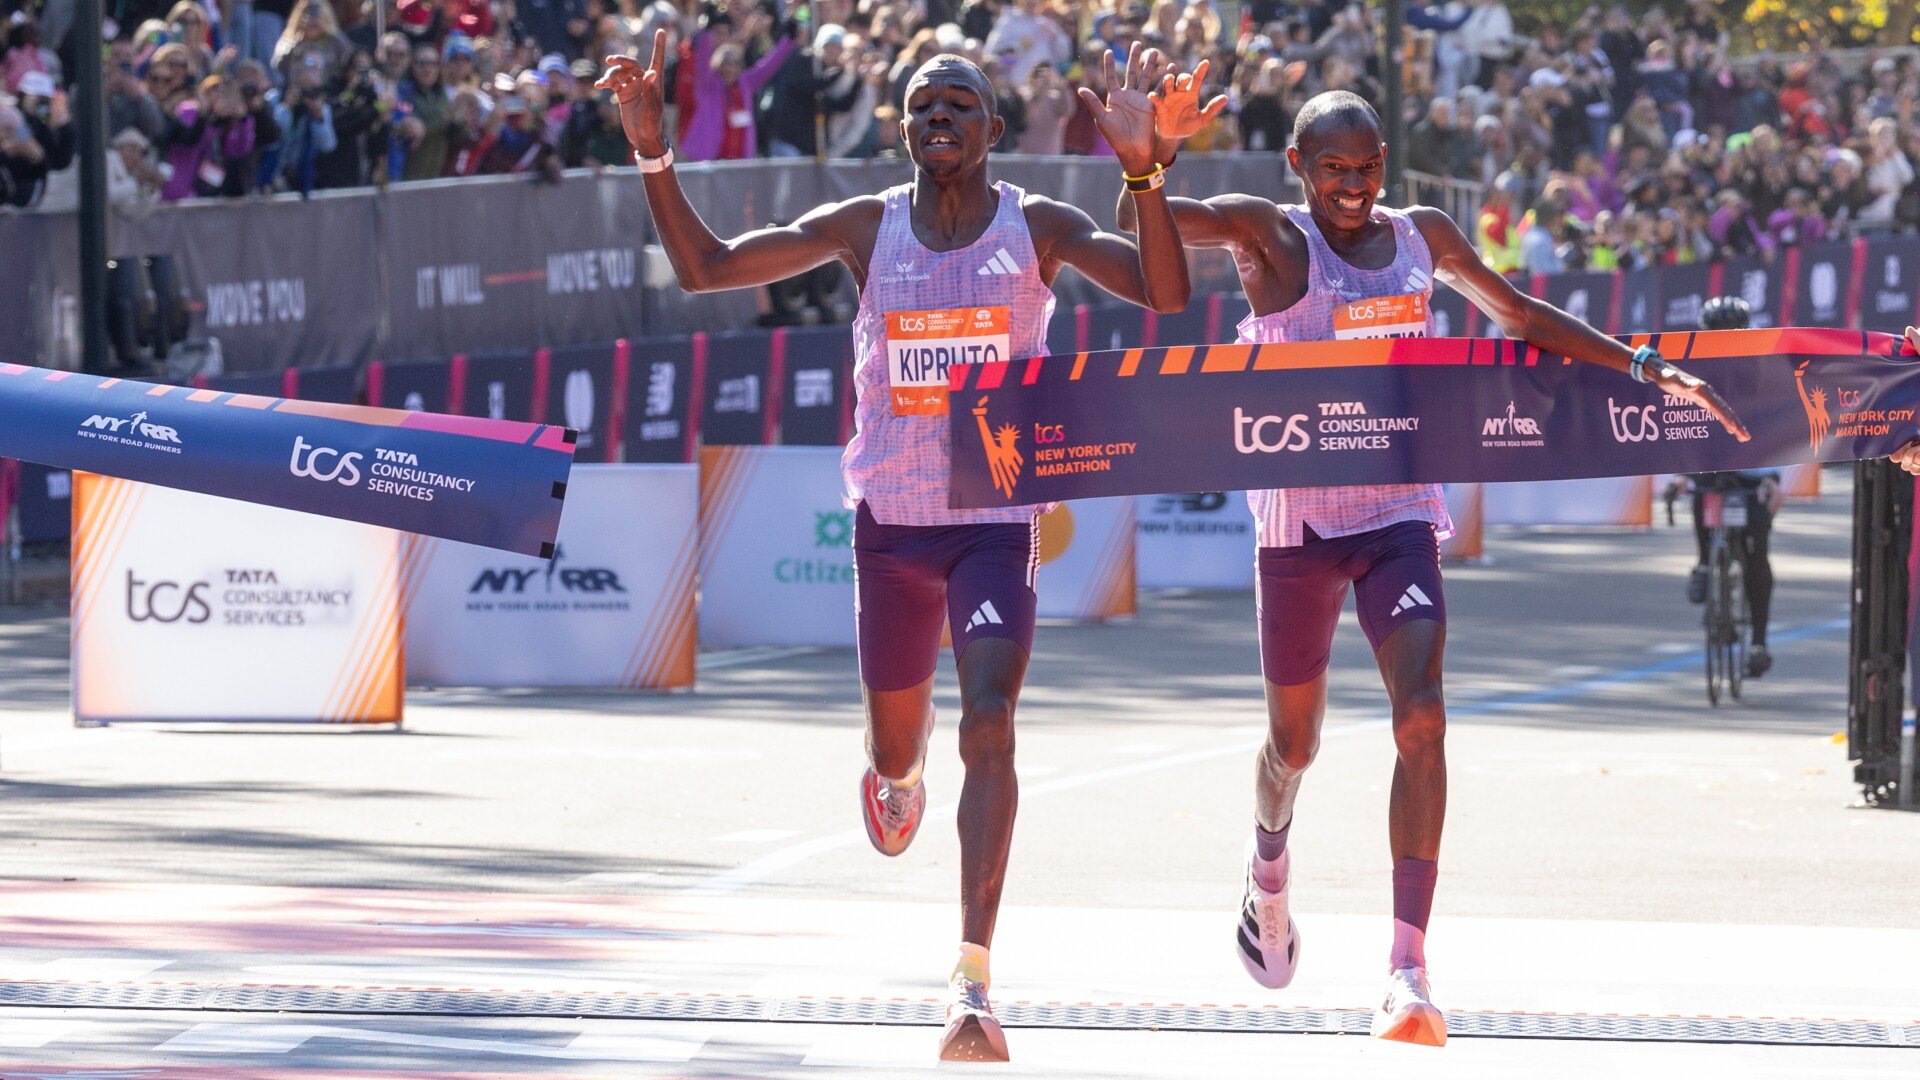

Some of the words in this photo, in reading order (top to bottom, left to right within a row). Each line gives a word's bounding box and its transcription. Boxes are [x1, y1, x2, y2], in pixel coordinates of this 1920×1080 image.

[416, 265, 435, 310] IT
[439, 262, 485, 307] WILL
[547, 250, 599, 295] MOVE
[206, 281, 263, 328] MOVE
[266, 276, 306, 323] YOU
[1348, 304, 1375, 320] tcs
[900, 315, 925, 332] tcs
[974, 321, 994, 329] TATA
[1838, 387, 1860, 407] tcs
[1318, 402, 1367, 416] TATA
[1662, 408, 1720, 424] CONSULTAN
[1838, 412, 1857, 424] NEW
[1889, 409, 1915, 422] CITY
[1318, 417, 1420, 433] CONSULTANCY
[1608, 397, 1660, 443] tcs
[1035, 422, 1065, 444] tcs
[1234, 407, 1311, 454] tcs
[1664, 425, 1710, 440] SERVICES
[1835, 424, 1890, 437] MARATHON
[77, 430, 97, 439] NEW
[98, 433, 119, 443] YORK
[120, 437, 143, 447] ROAD
[144, 442, 182, 454] RUNNERS
[1319, 435, 1391, 451] SERVICES
[290, 435, 364, 487] tcs
[375, 448, 418, 466] TATA
[1035, 447, 1065, 462] NEW
[1067, 444, 1103, 459] YORK
[1105, 442, 1137, 456] CITY
[1035, 459, 1111, 477] MARATHON
[371, 463, 476, 493] CONSULTANCY
[367, 478, 434, 502] SERVICES
[224, 569, 278, 584] TATA
[774, 557, 855, 584] Citize
[125, 568, 211, 624] tcs
[222, 589, 353, 606] CONSULTANCY
[222, 609, 306, 627] SERVICES
